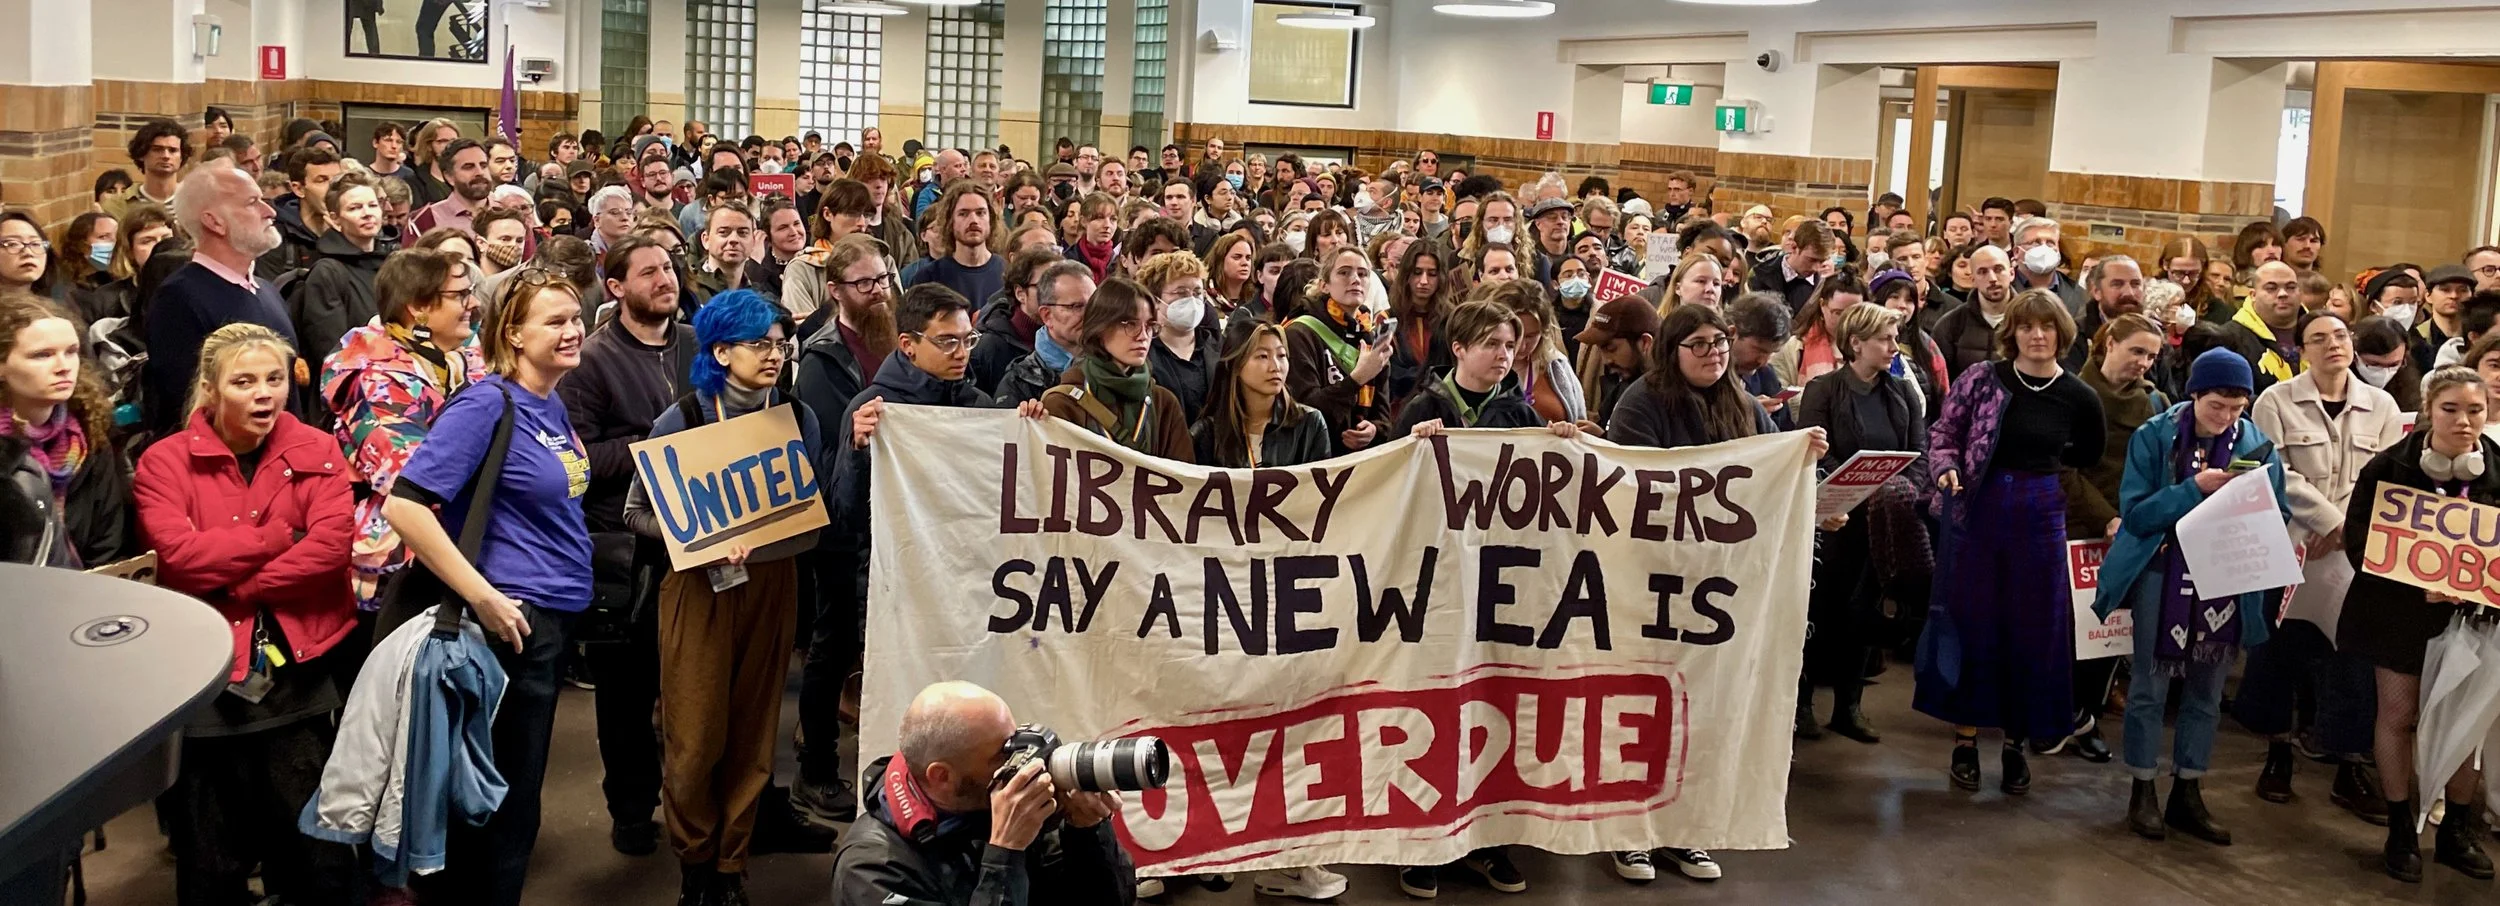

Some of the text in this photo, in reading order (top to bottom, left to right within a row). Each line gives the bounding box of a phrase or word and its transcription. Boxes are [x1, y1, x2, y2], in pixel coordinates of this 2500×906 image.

[757, 181, 785, 190] Union
[1649, 235, 1676, 245] STAF
[1606, 276, 1627, 292] I'M
[1839, 471, 1891, 482] STRIKE
[1876, 459, 1902, 470] ON
[638, 440, 819, 543] UNITED
[1000, 434, 1757, 546] LIBRARY WORKERS
[2379, 488, 2500, 547] SECU
[988, 545, 1739, 656] SAY A NEW EA IS
[889, 771, 914, 819] Canon
[1119, 693, 1657, 851] OVERDUE
